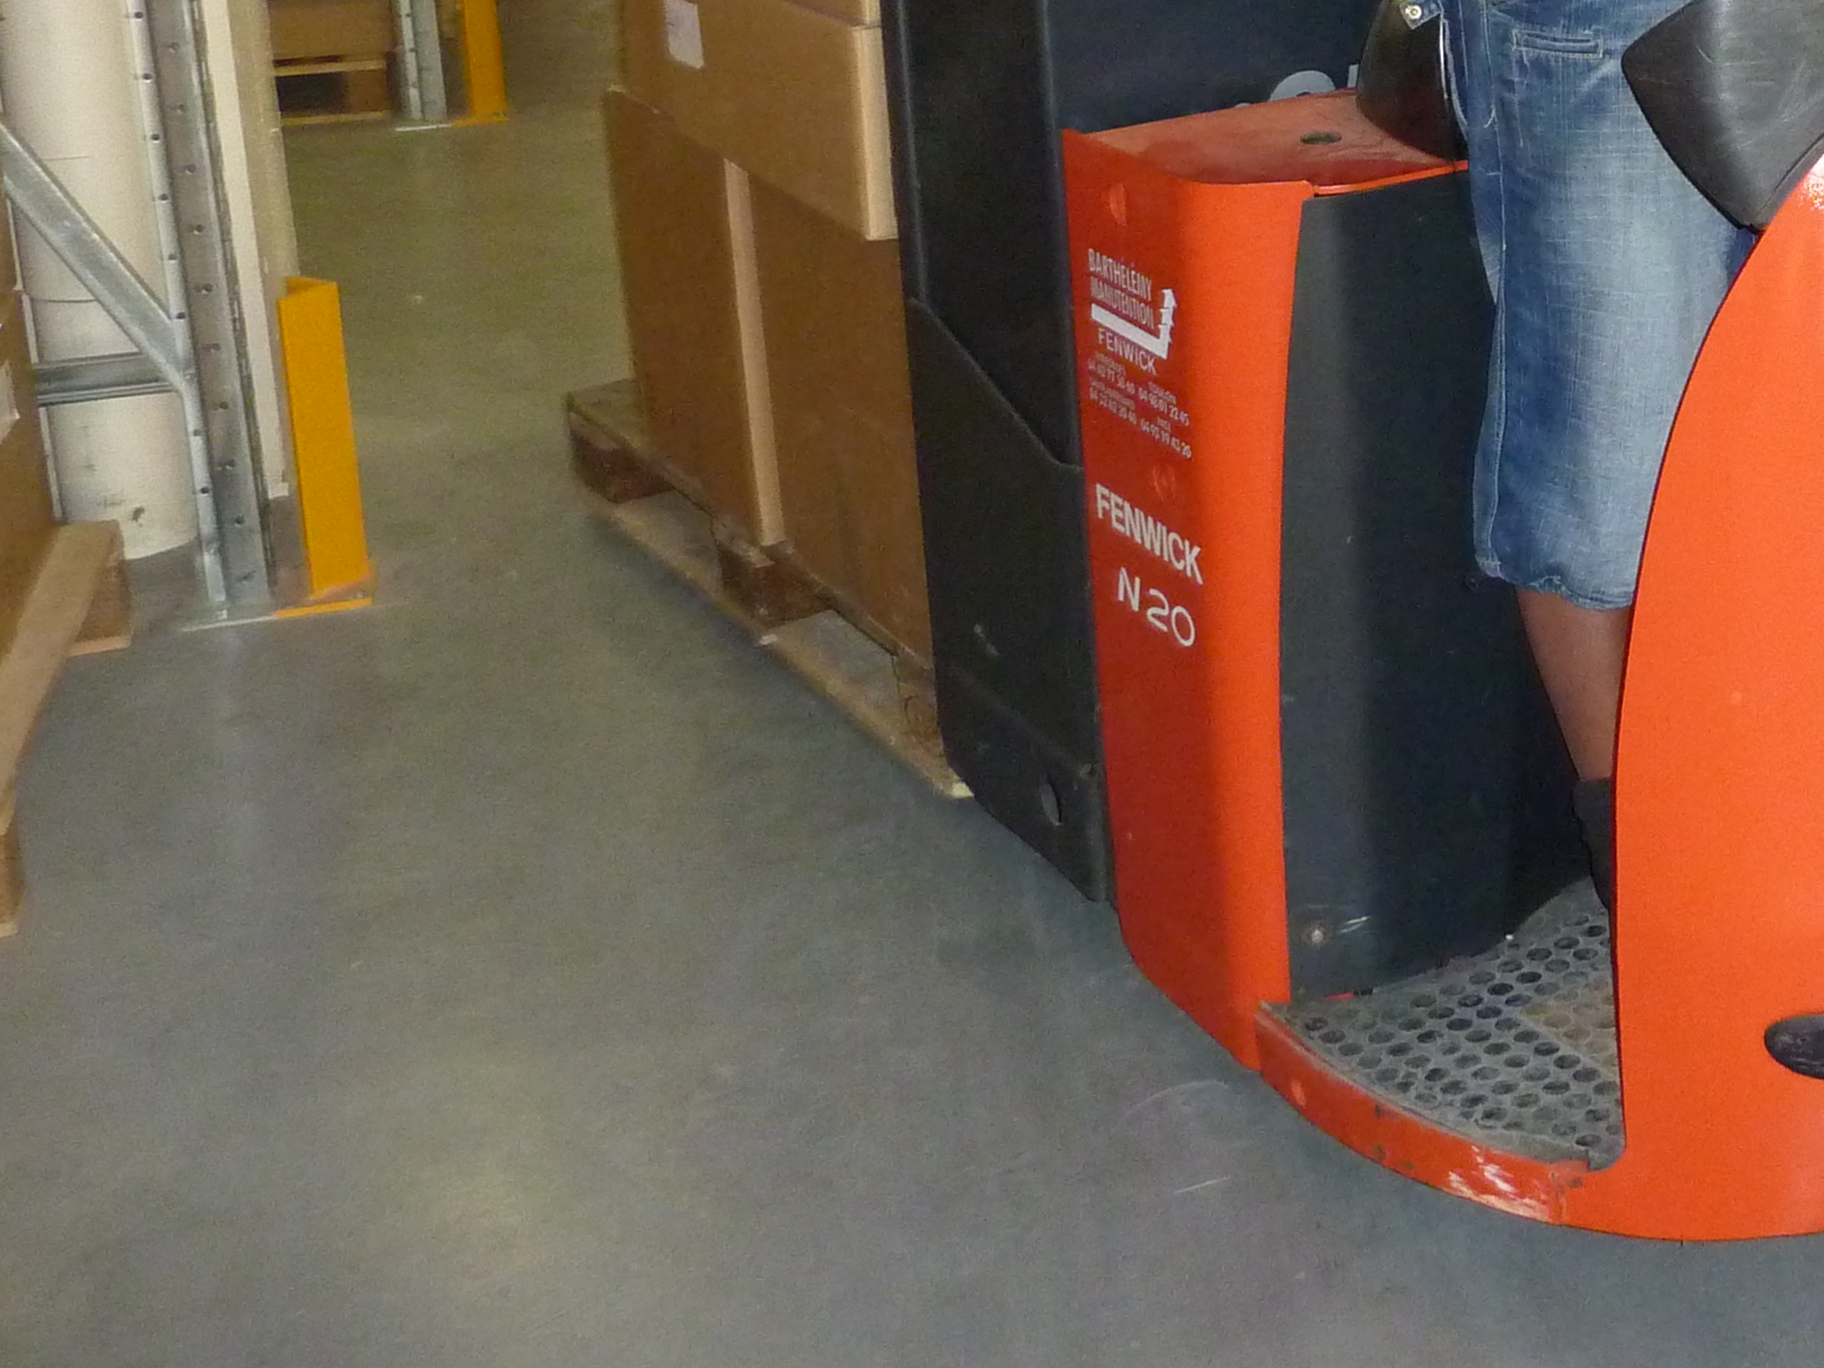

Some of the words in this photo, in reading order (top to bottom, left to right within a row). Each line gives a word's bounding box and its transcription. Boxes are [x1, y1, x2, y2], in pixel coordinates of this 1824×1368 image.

[1099, 327, 1157, 376] FENWICK
[1096, 483, 1203, 585] FENWICK
[1118, 566, 1141, 612] N
[1147, 588, 1195, 647] 20
